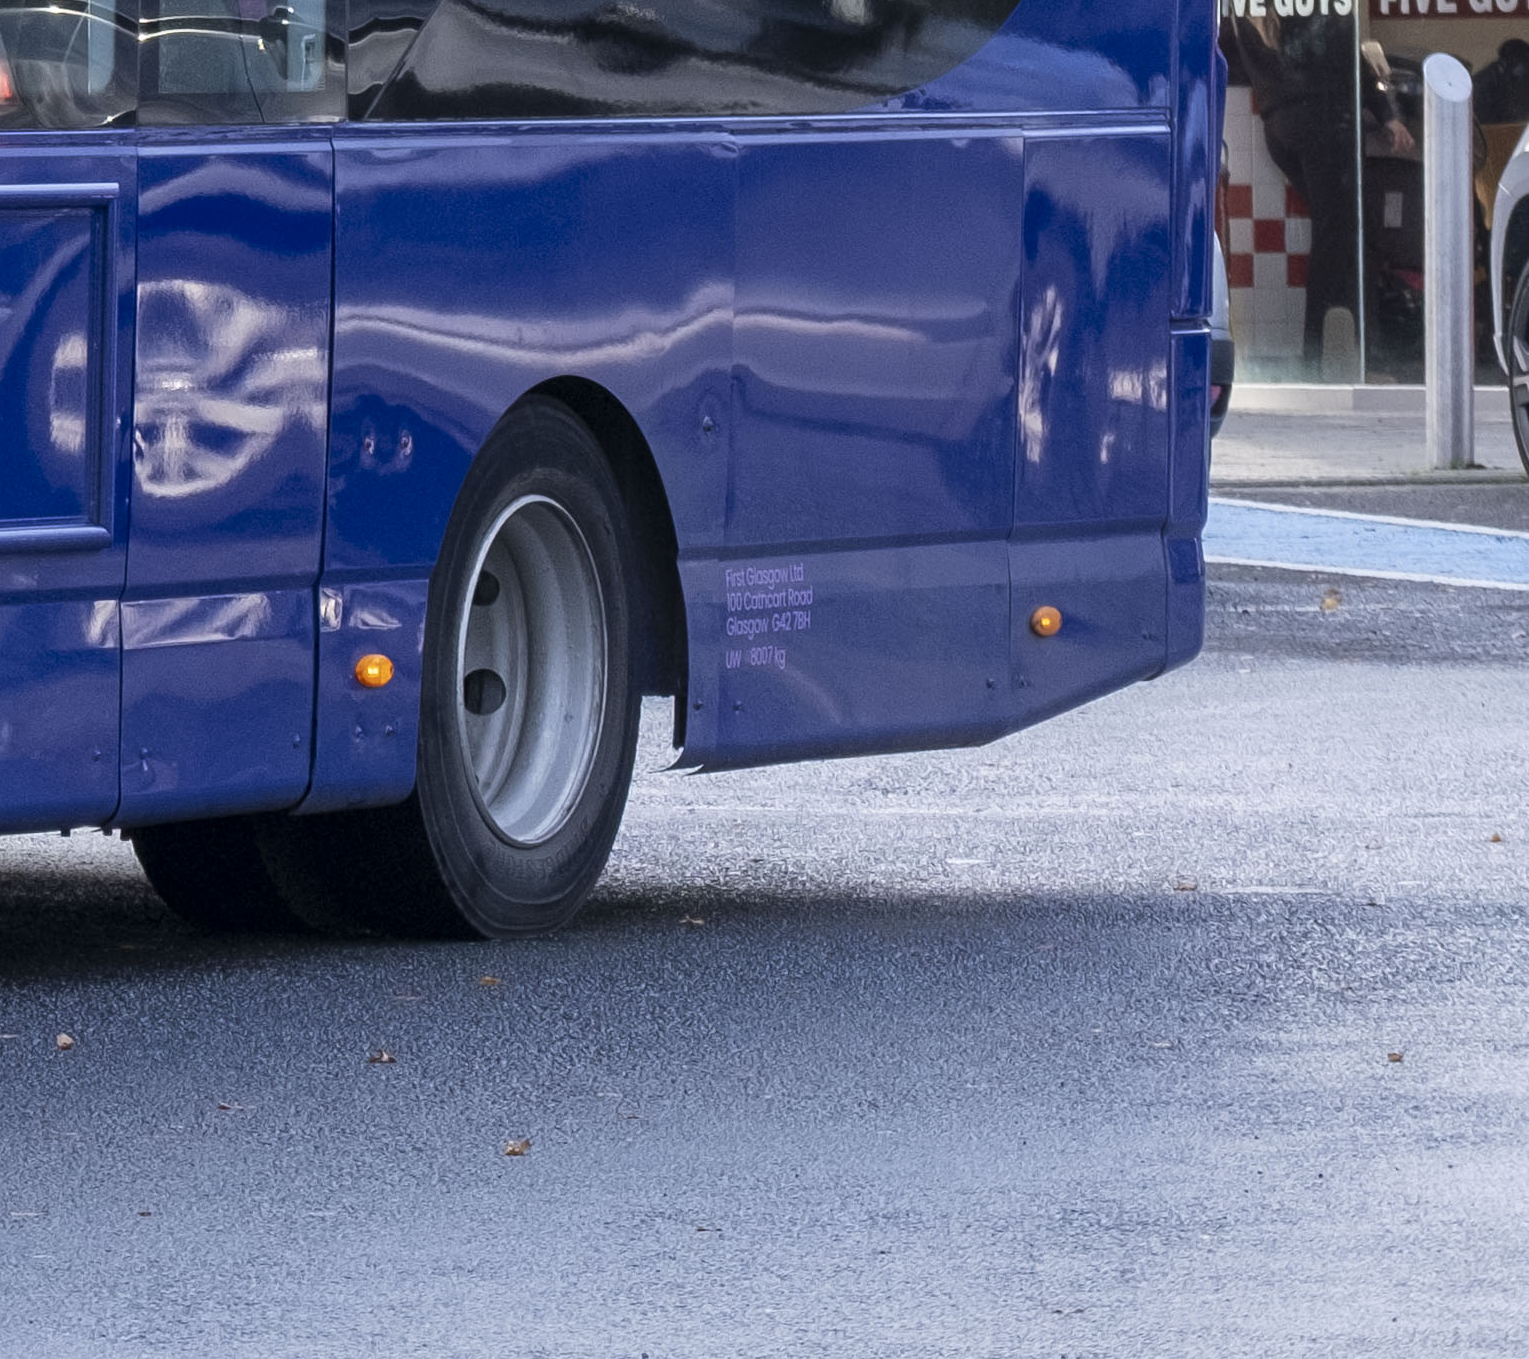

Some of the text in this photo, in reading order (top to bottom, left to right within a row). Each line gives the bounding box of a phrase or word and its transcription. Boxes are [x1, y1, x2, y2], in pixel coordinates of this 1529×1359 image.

[725, 562, 805, 590] First Glasgow Ltd
[726, 584, 814, 612] 100 Cathcart Road
[726, 616, 769, 641] Glasgow
[772, 611, 792, 632] G42
[774, 645, 787, 670] kg
